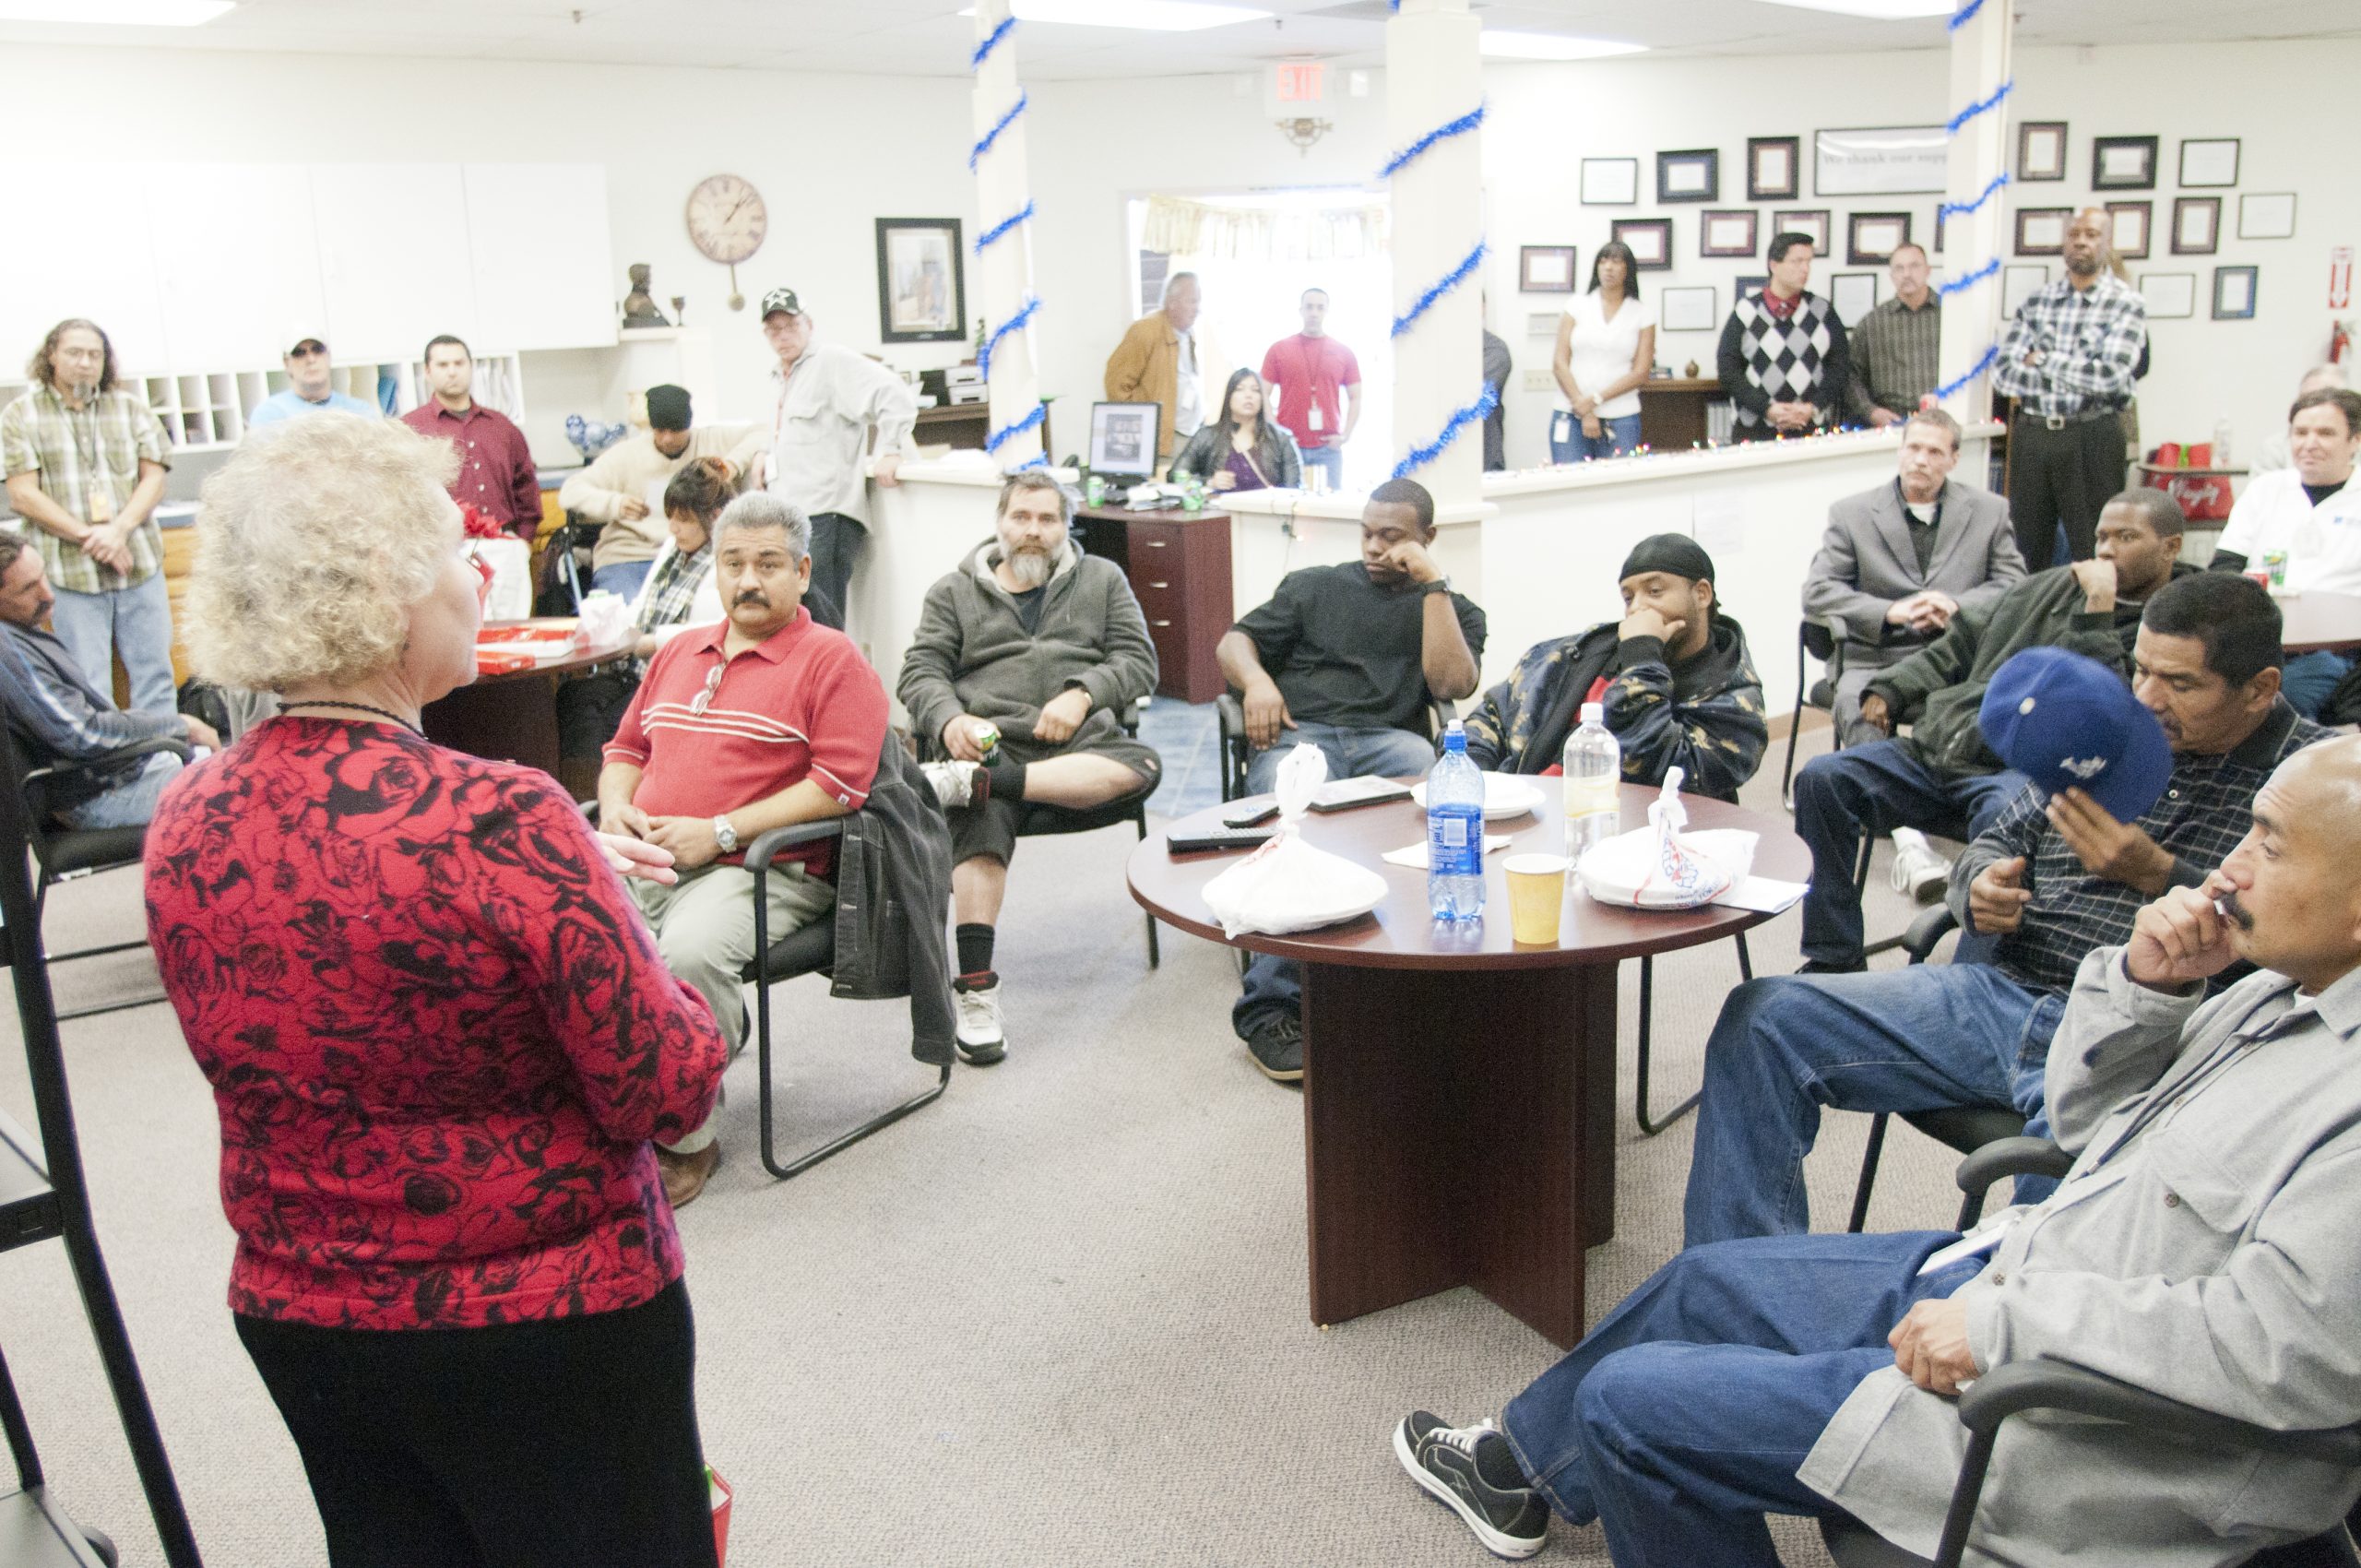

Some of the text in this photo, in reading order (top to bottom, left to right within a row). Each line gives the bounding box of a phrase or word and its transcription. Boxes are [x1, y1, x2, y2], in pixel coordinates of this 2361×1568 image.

[1277, 64, 1325, 101] EXIT
[1822, 154, 1844, 164] We
[1846, 151, 1886, 164] thank
[1890, 154, 1913, 163] our
